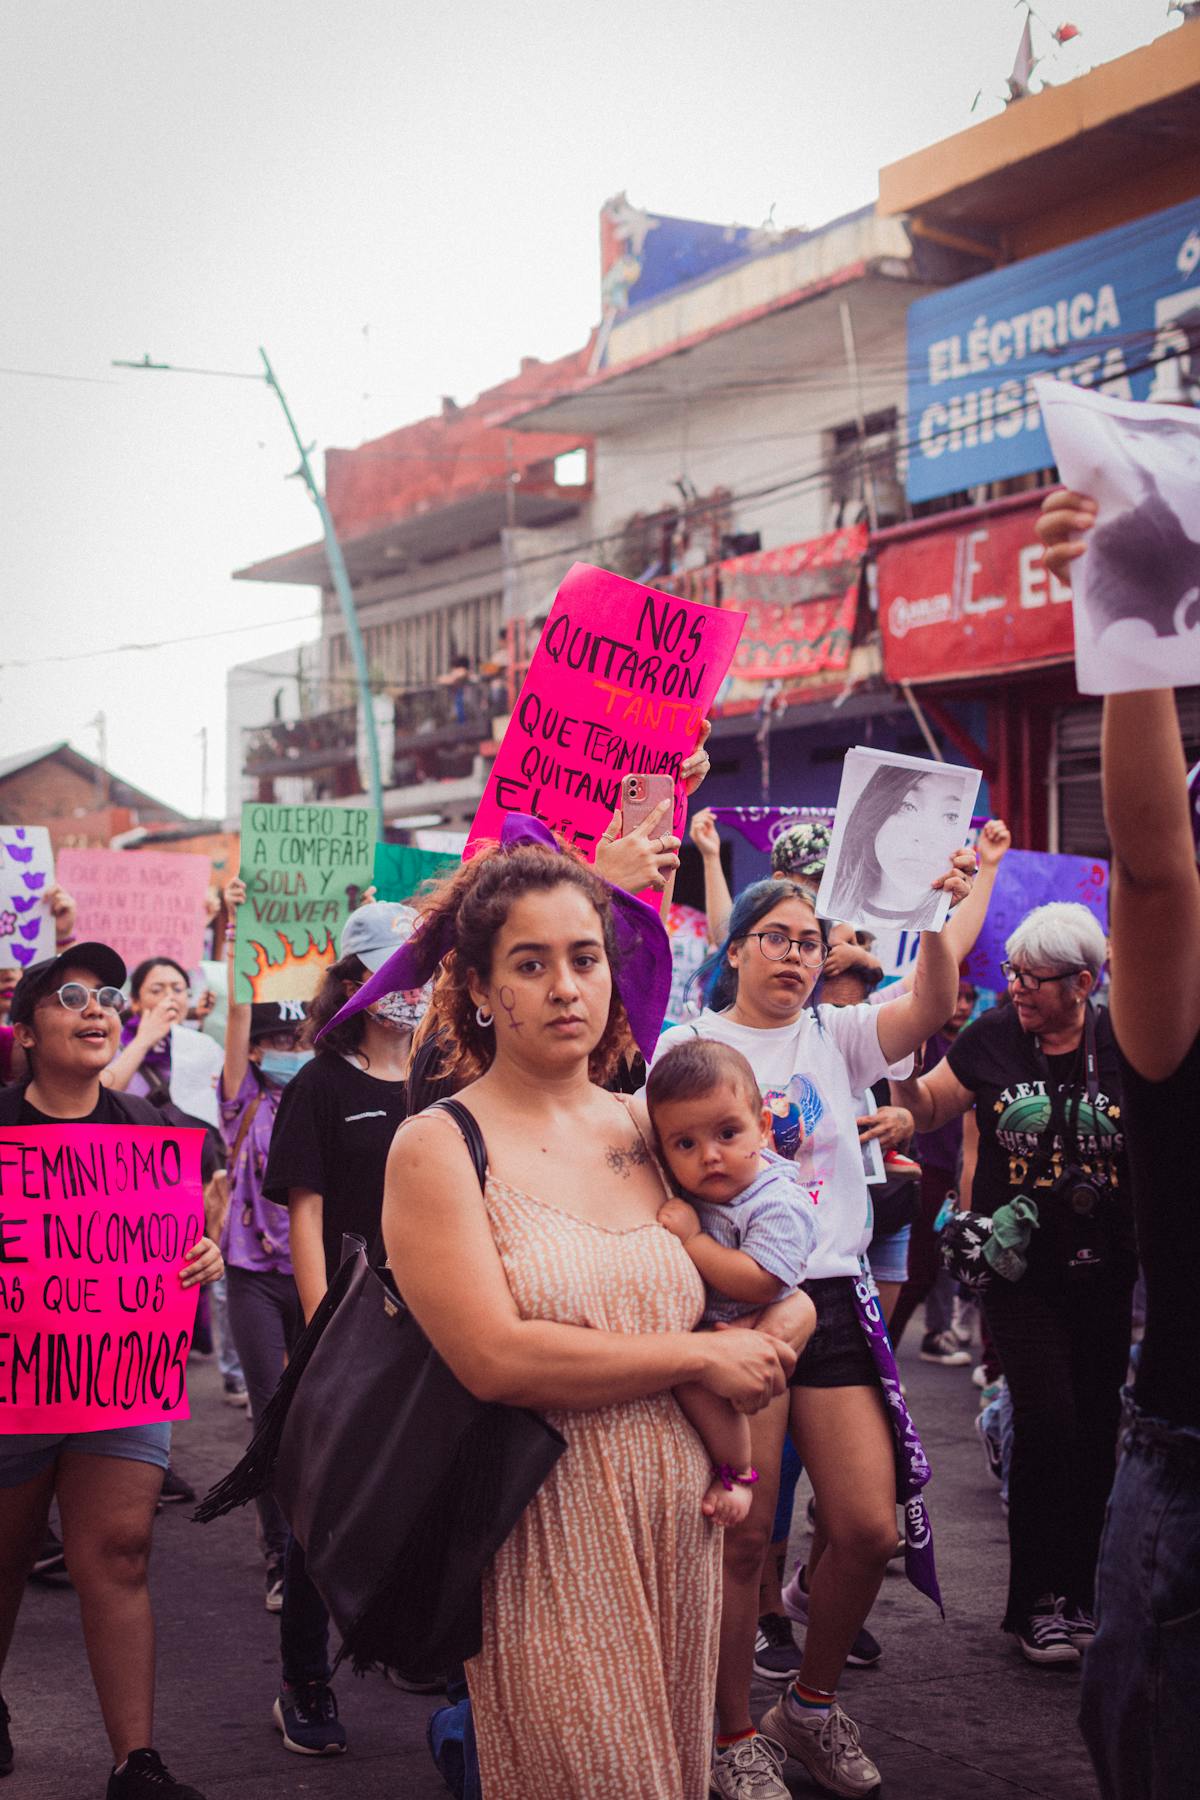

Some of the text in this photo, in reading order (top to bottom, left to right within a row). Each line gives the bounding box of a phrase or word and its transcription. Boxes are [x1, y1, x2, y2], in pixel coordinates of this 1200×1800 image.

[928, 284, 1120, 386] ELÉCTRICA
[636, 595, 706, 663] NOS
[545, 614, 706, 699] QUITARON
[518, 693, 579, 748] QUE
[593, 679, 703, 737] TANTO
[252, 807, 369, 837] QUIERO IR
[495, 775, 549, 822] EL
[253, 838, 369, 866] A COMPRAR
[252, 869, 334, 896] SOLA Y
[252, 897, 340, 924] VOLVER
[1000, 1080, 1046, 1105] LET
[0, 1140, 181, 1199] FEMINISMO
[42, 1210, 199, 1264] INCOMODA
[43, 1275, 102, 1313] QUE
[118, 1274, 165, 1313] LOS
[0, 1330, 189, 1411] EMINICIDIOS
